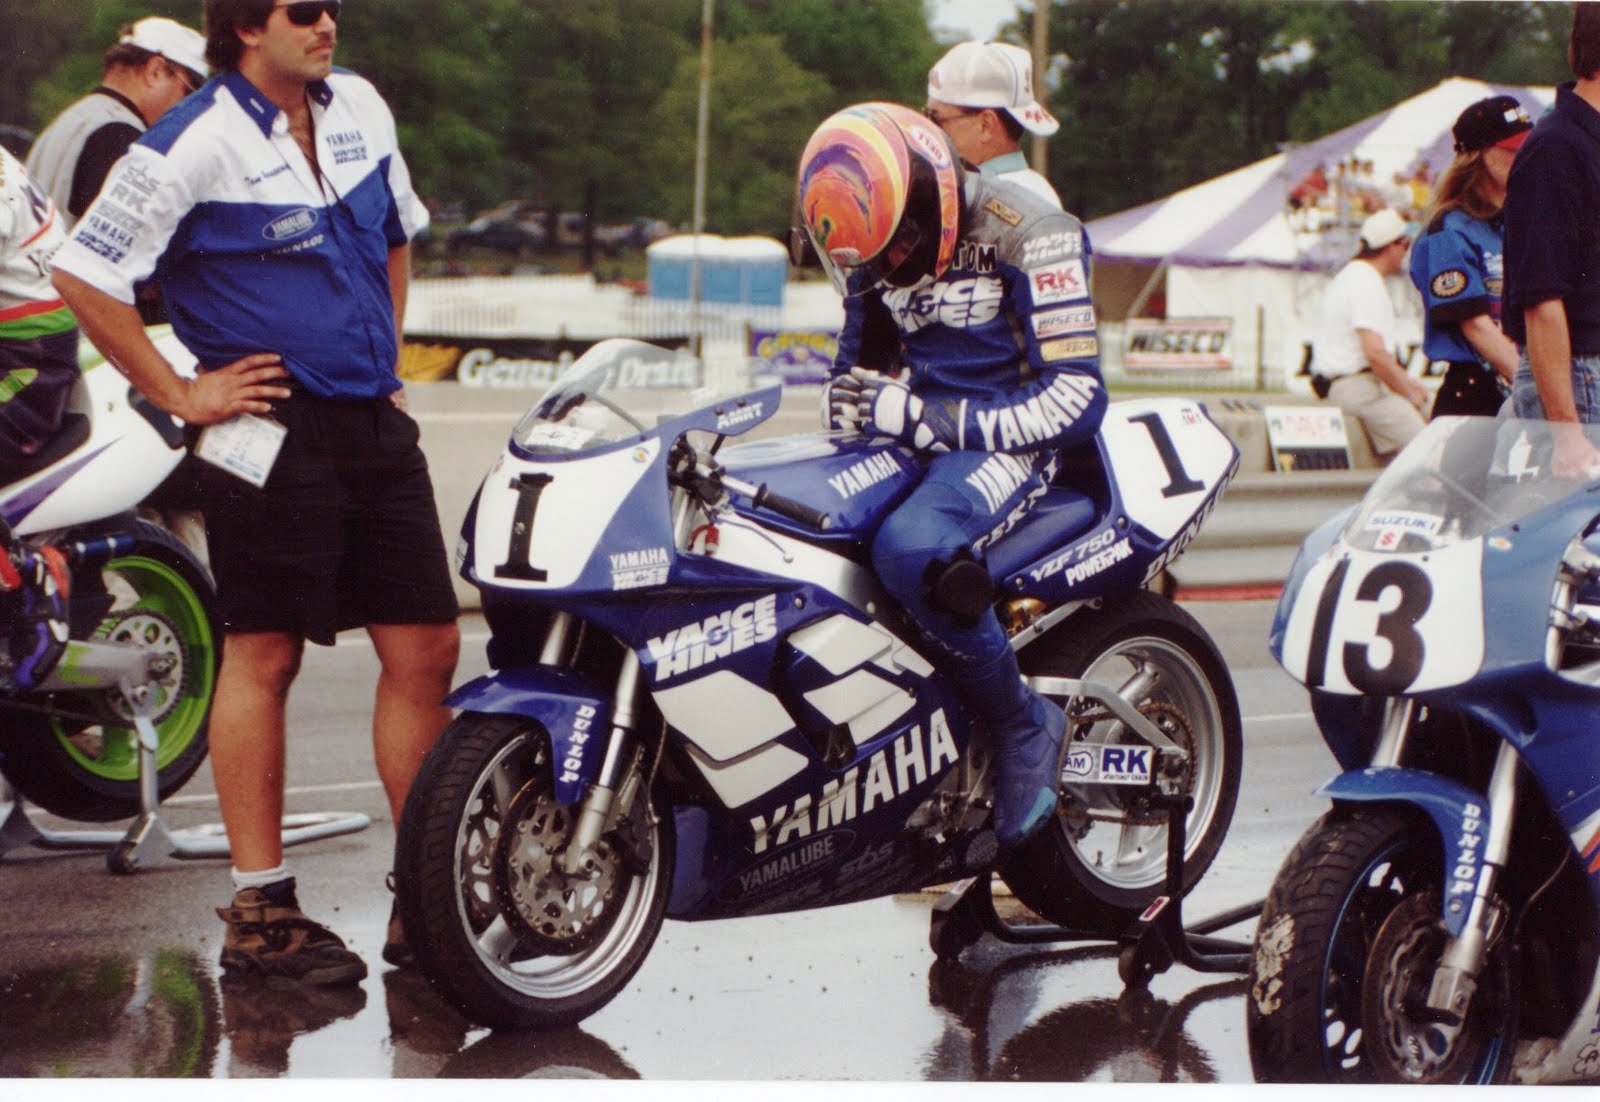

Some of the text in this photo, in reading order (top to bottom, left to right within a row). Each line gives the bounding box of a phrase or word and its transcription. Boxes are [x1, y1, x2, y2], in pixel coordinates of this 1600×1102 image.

[109, 183, 150, 215] RK
[1035, 268, 1079, 292] RK
[977, 373, 1099, 452] YAMAHA
[827, 450, 902, 499] YAMAHA
[1127, 410, 1206, 499] 1
[1371, 516, 1437, 530] SUZUKI
[610, 547, 669, 570] YAMAHA
[1030, 528, 1116, 583] YZF 750
[647, 593, 777, 659] VANCE
[655, 616, 777, 682] HINES
[1305, 554, 1434, 697] 13
[559, 704, 597, 784] DUNLOP
[1102, 747, 1148, 774] RK
[750, 707, 959, 854] YAMAHA
[739, 834, 834, 892] YAMALUBE
[1450, 802, 1481, 895] DUNLOP
